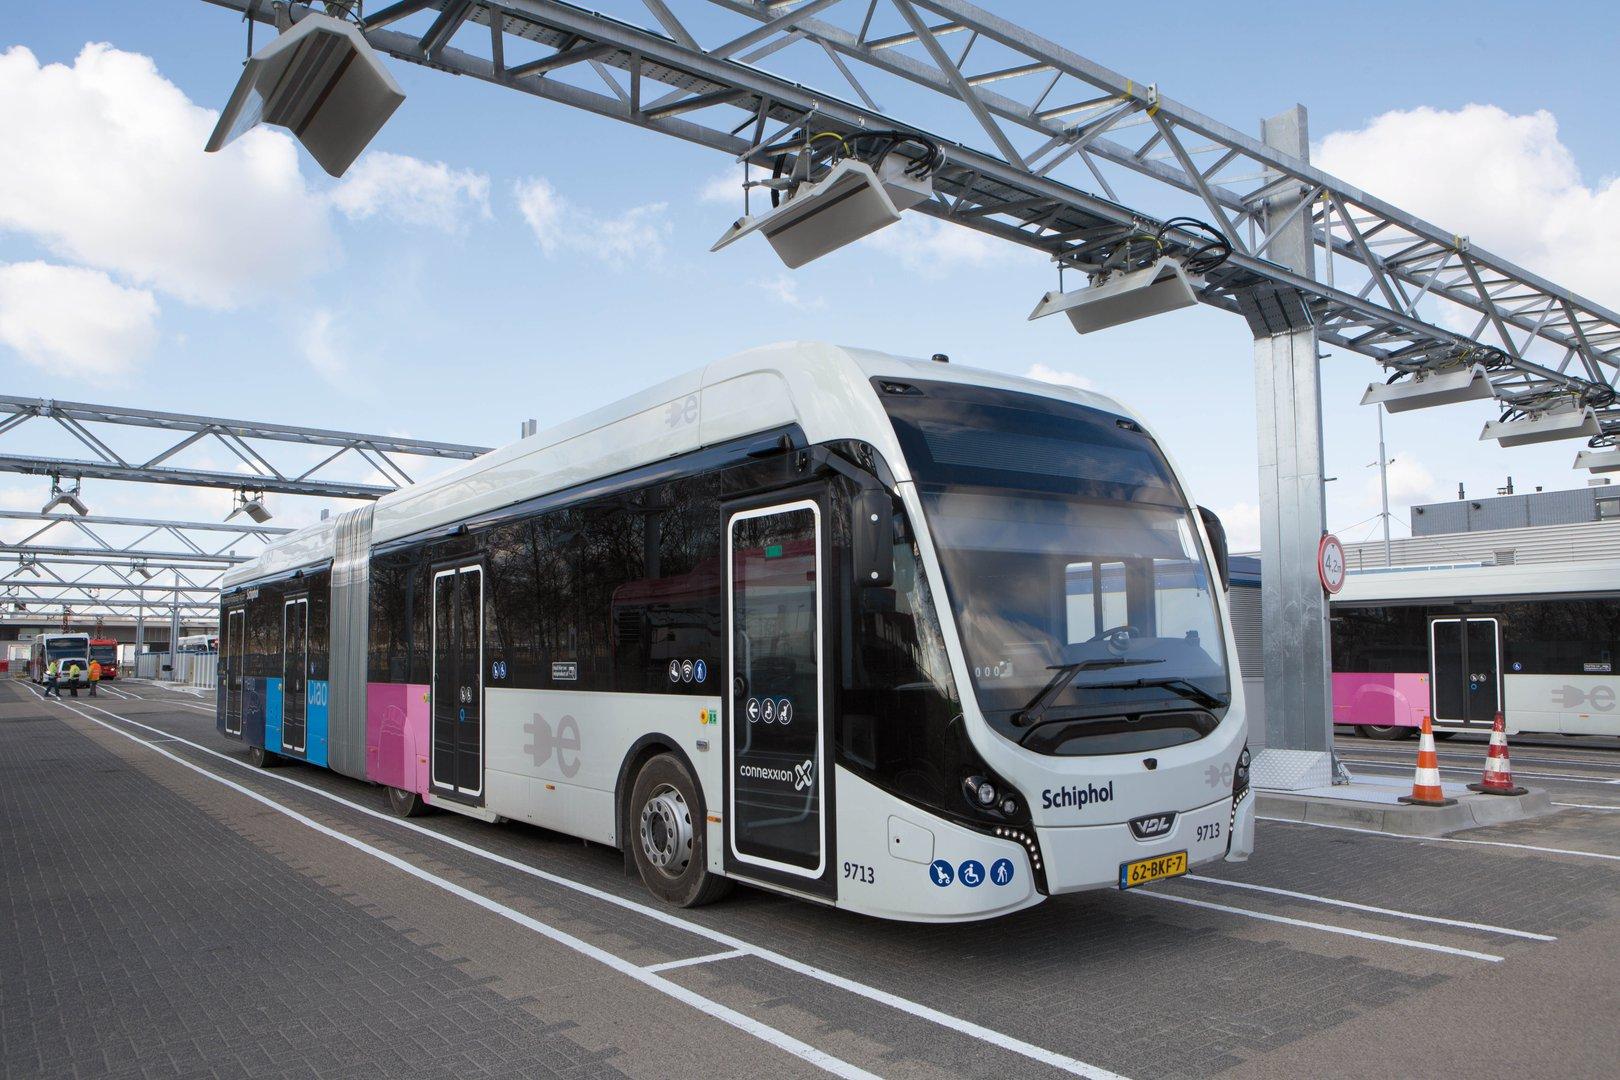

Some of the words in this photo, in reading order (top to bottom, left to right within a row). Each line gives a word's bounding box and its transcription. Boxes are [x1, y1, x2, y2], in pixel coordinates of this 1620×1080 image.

[740, 765, 793, 782] connexxion
[1042, 781, 1113, 810] Schiphol
[1136, 816, 1170, 834] VDL
[1196, 822, 1220, 842] 9713
[844, 862, 875, 884] 9713
[1132, 856, 1182, 881] 62-BKF-7
